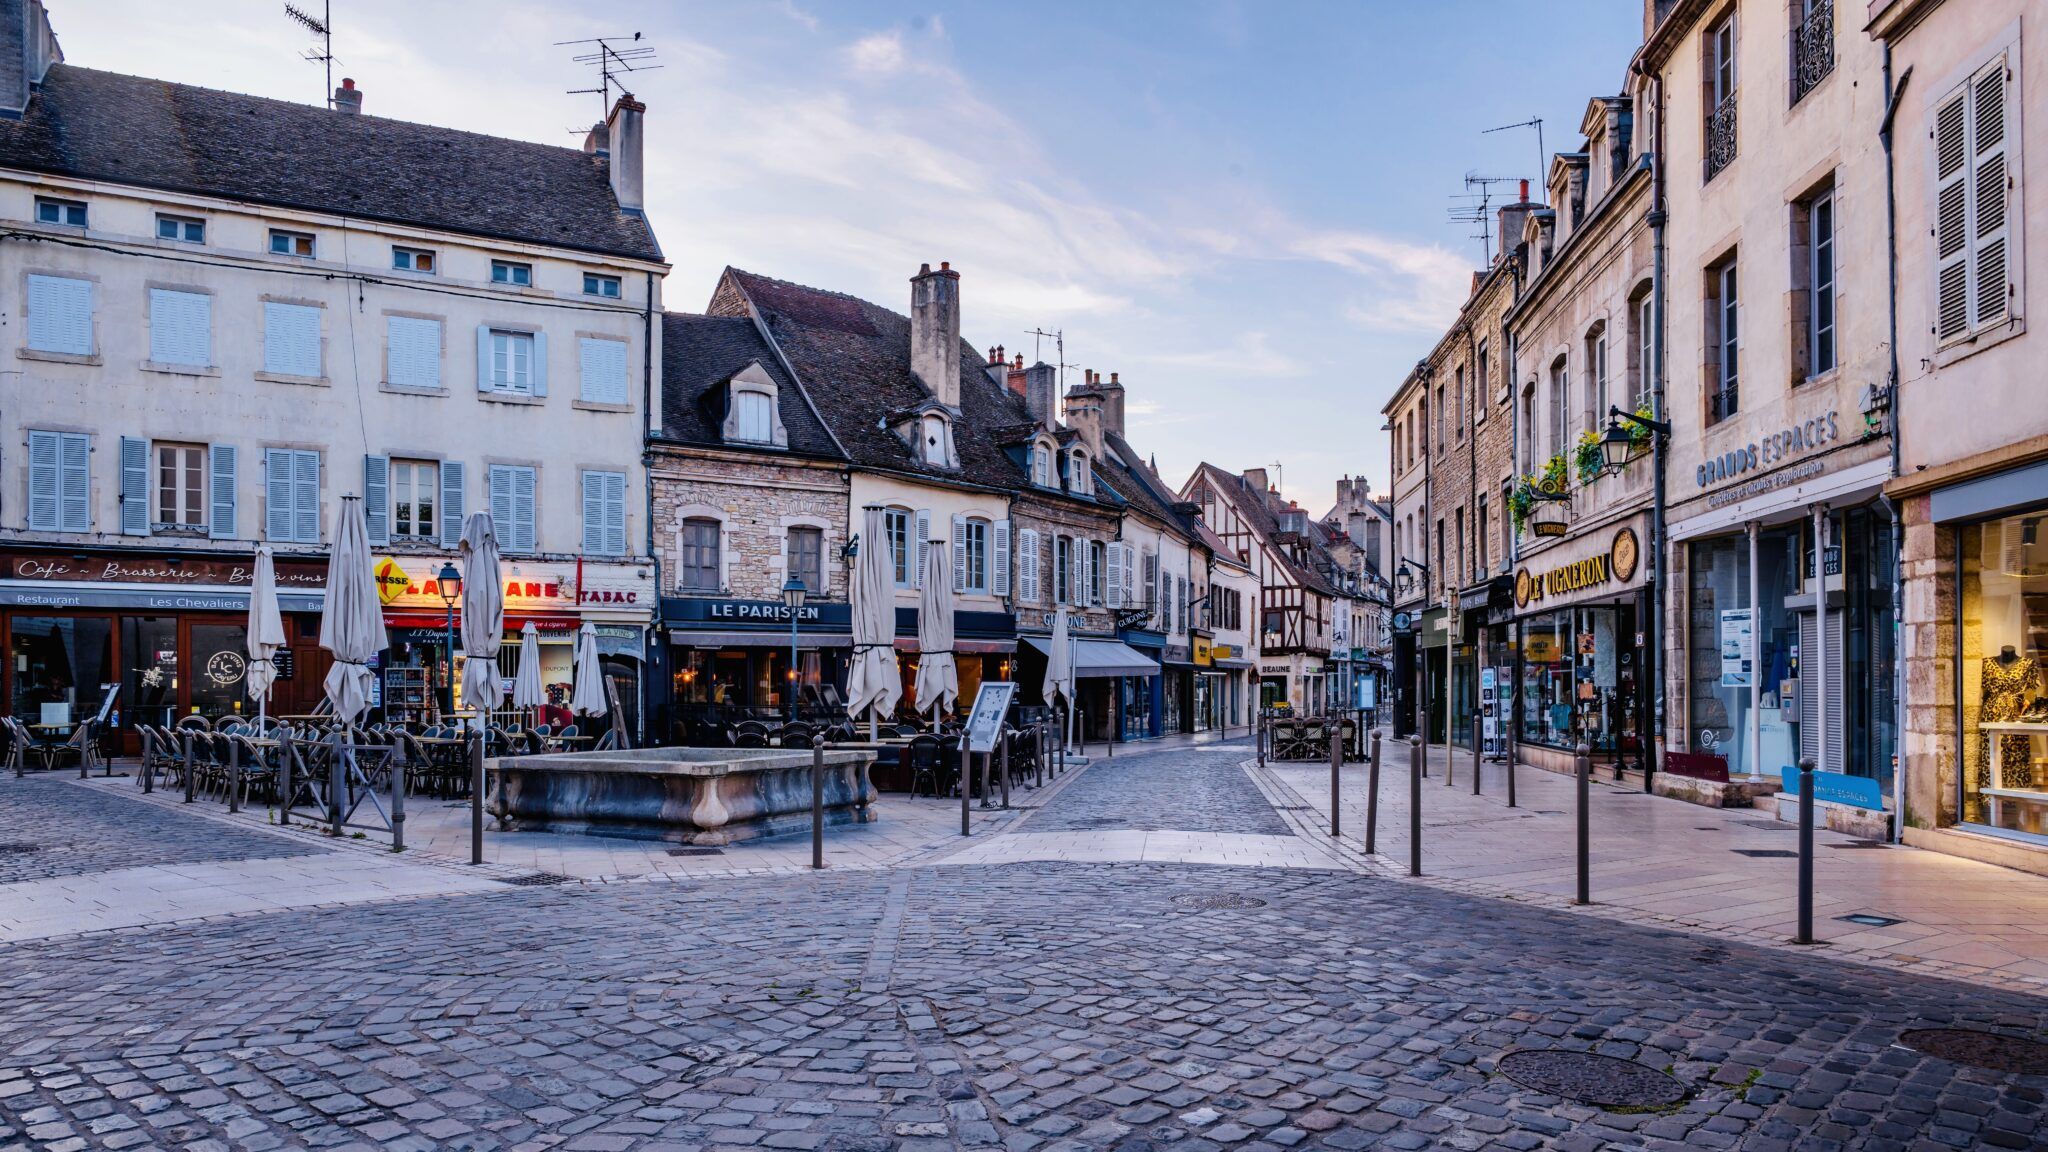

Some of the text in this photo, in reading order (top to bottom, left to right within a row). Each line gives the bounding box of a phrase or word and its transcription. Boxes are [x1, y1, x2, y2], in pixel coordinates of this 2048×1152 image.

[1696, 410, 1838, 487] GRANDS ESPACES
[1810, 551, 1838, 565] GNDS
[18, 560, 70, 578] Café
[102, 561, 200, 579] Brasserie
[228, 567, 255, 583] Ba
[290, 573, 326, 582] vins
[1529, 575, 1541, 600] LE
[1544, 553, 1607, 595] VIGNERON
[1810, 563, 1838, 577] ESCES
[374, 575, 409, 586] RESSE
[406, 580, 440, 595] LA
[17, 594, 80, 605] Restaurant
[150, 597, 172, 607] Les
[176, 597, 245, 608] Chevaliers
[580, 591, 637, 603] TABAC
[711, 604, 733, 617] LE
[1043, 612, 1087, 628] GUONE
[1118, 609, 1148, 628] GUIGONE
[425, 629, 450, 640] Dupon
[1637, 635, 1644, 645] 6
[211, 656, 221, 669] BAR
[230, 655, 242, 668] VINS
[1262, 665, 1291, 673] BEAUNE
